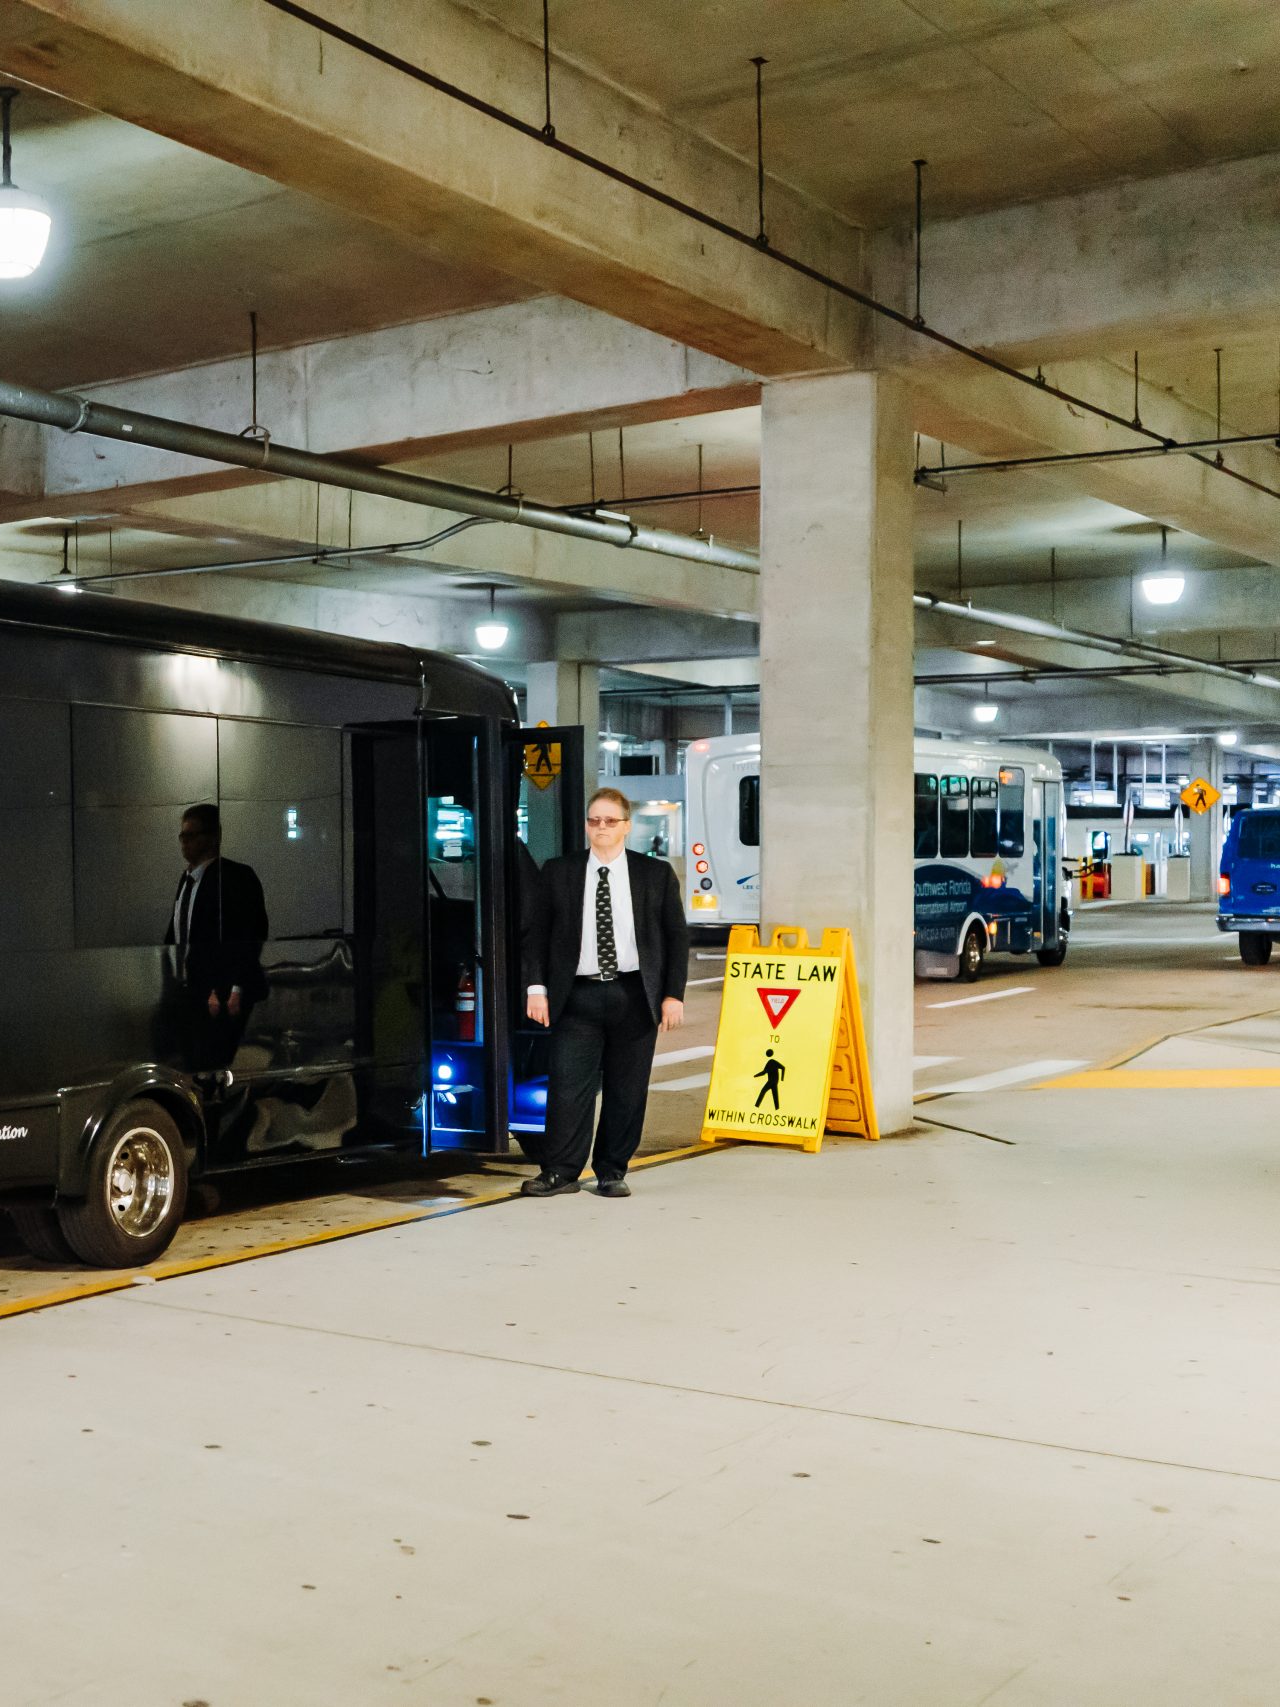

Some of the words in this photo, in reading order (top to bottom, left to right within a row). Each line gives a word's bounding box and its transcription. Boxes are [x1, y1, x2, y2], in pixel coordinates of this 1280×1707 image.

[914, 882, 948, 897] outhwest
[948, 880, 972, 895] Florida
[730, 962, 786, 980] STATE
[798, 964, 837, 982] LAW
[769, 1035, 780, 1043] TO
[708, 1109, 745, 1124] WITHIN
[749, 1112, 818, 1129] CROSSWALK
